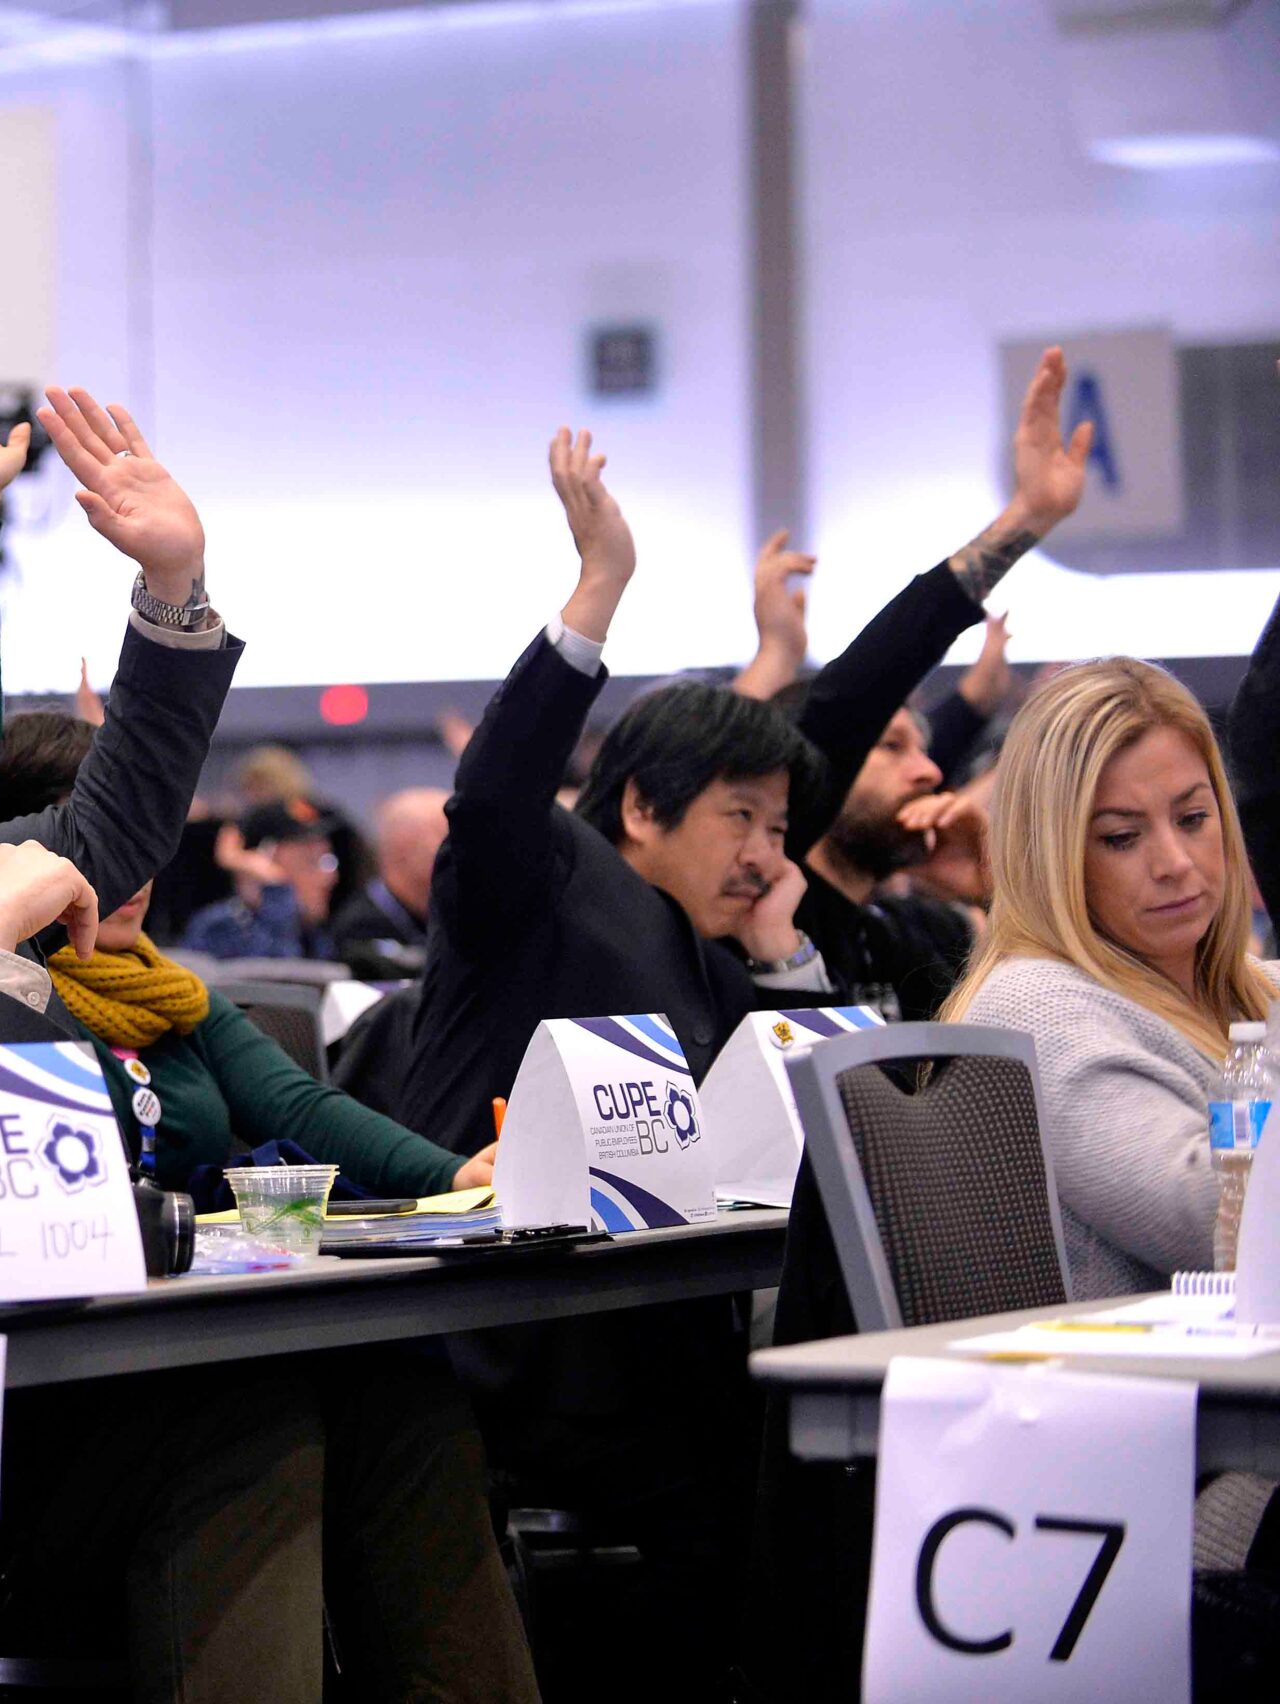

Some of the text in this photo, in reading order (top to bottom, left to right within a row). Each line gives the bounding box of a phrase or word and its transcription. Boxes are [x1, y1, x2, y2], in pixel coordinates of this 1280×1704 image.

[593, 1081, 662, 1121] CUPE
[635, 1118, 669, 1156] BC
[40, 1216, 113, 1262] 1004
[914, 1508, 1126, 1663] C7
